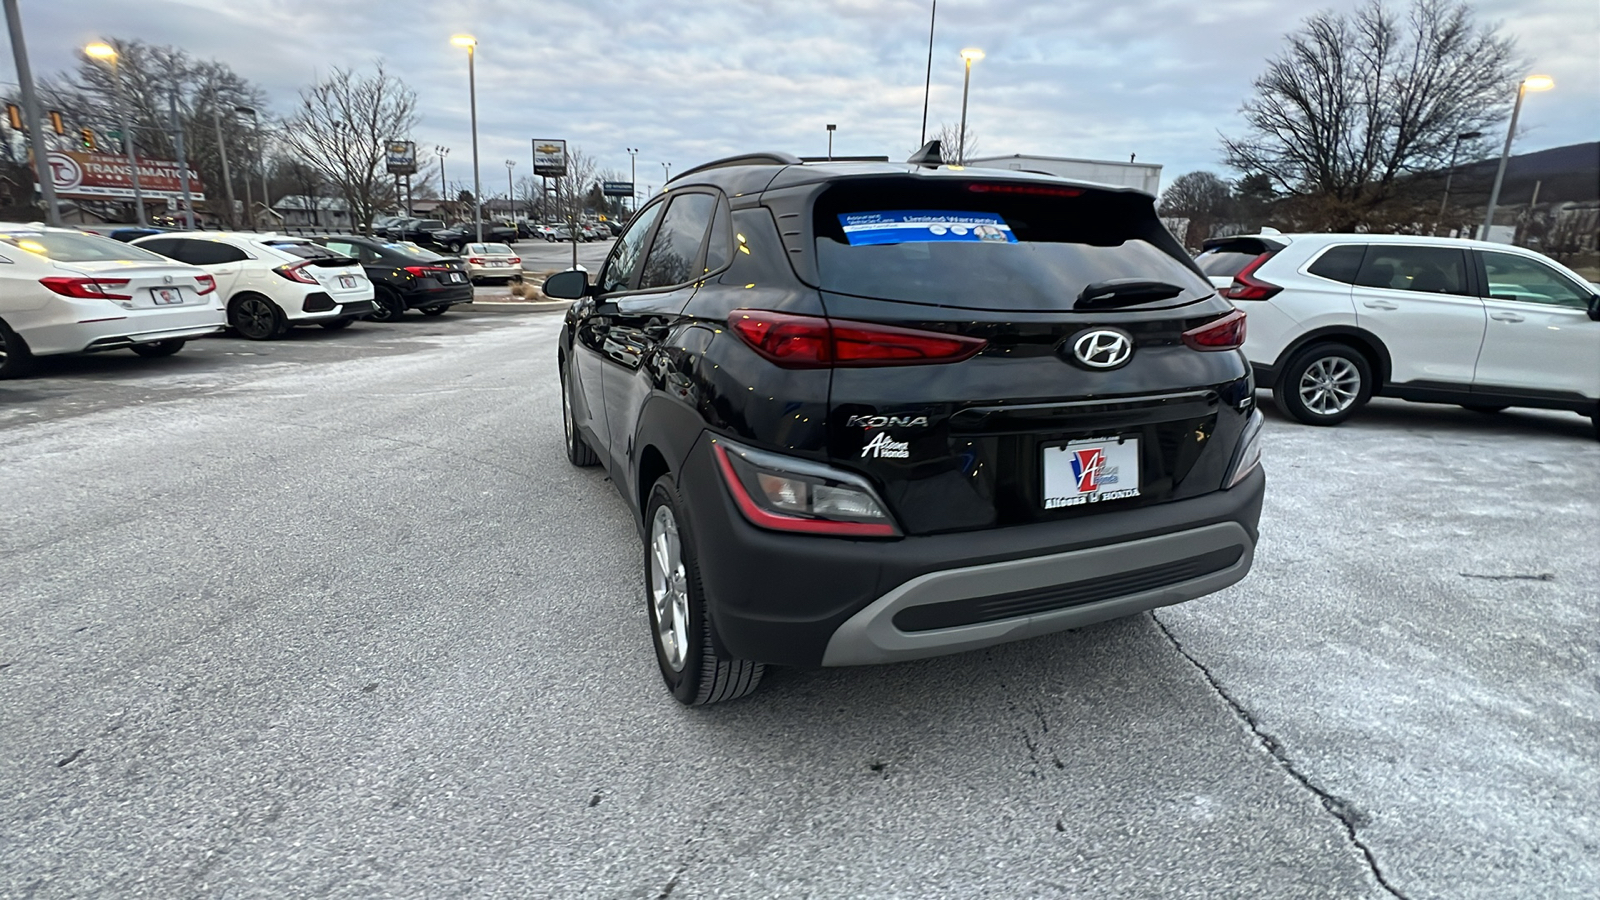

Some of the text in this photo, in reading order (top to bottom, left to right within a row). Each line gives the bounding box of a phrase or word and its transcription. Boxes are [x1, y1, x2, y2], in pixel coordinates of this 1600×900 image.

[846, 415, 928, 427] KONA
[881, 450, 909, 458] Honda
[1044, 487, 1141, 509] Altoona HONDA
